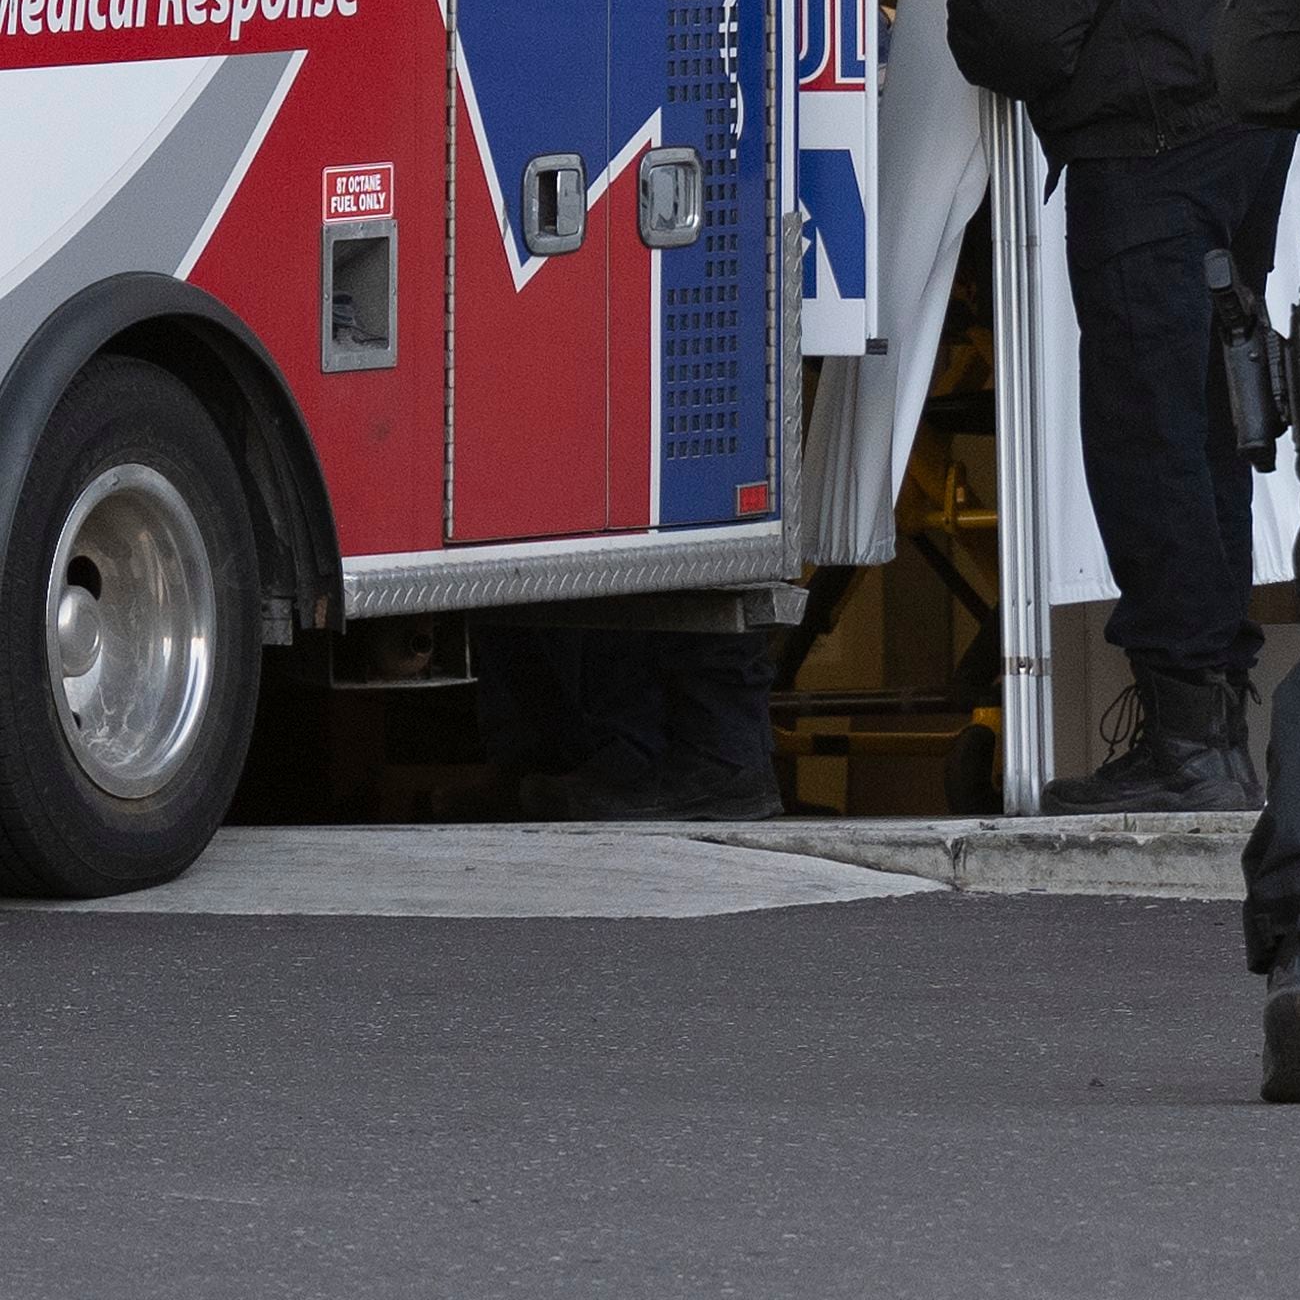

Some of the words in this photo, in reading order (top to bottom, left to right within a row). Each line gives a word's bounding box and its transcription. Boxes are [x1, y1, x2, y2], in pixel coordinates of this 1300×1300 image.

[336, 176, 347, 195] 87
[348, 173, 382, 194] OCTANE
[330, 195, 358, 214] FUEL
[359, 192, 387, 212] ONLY
